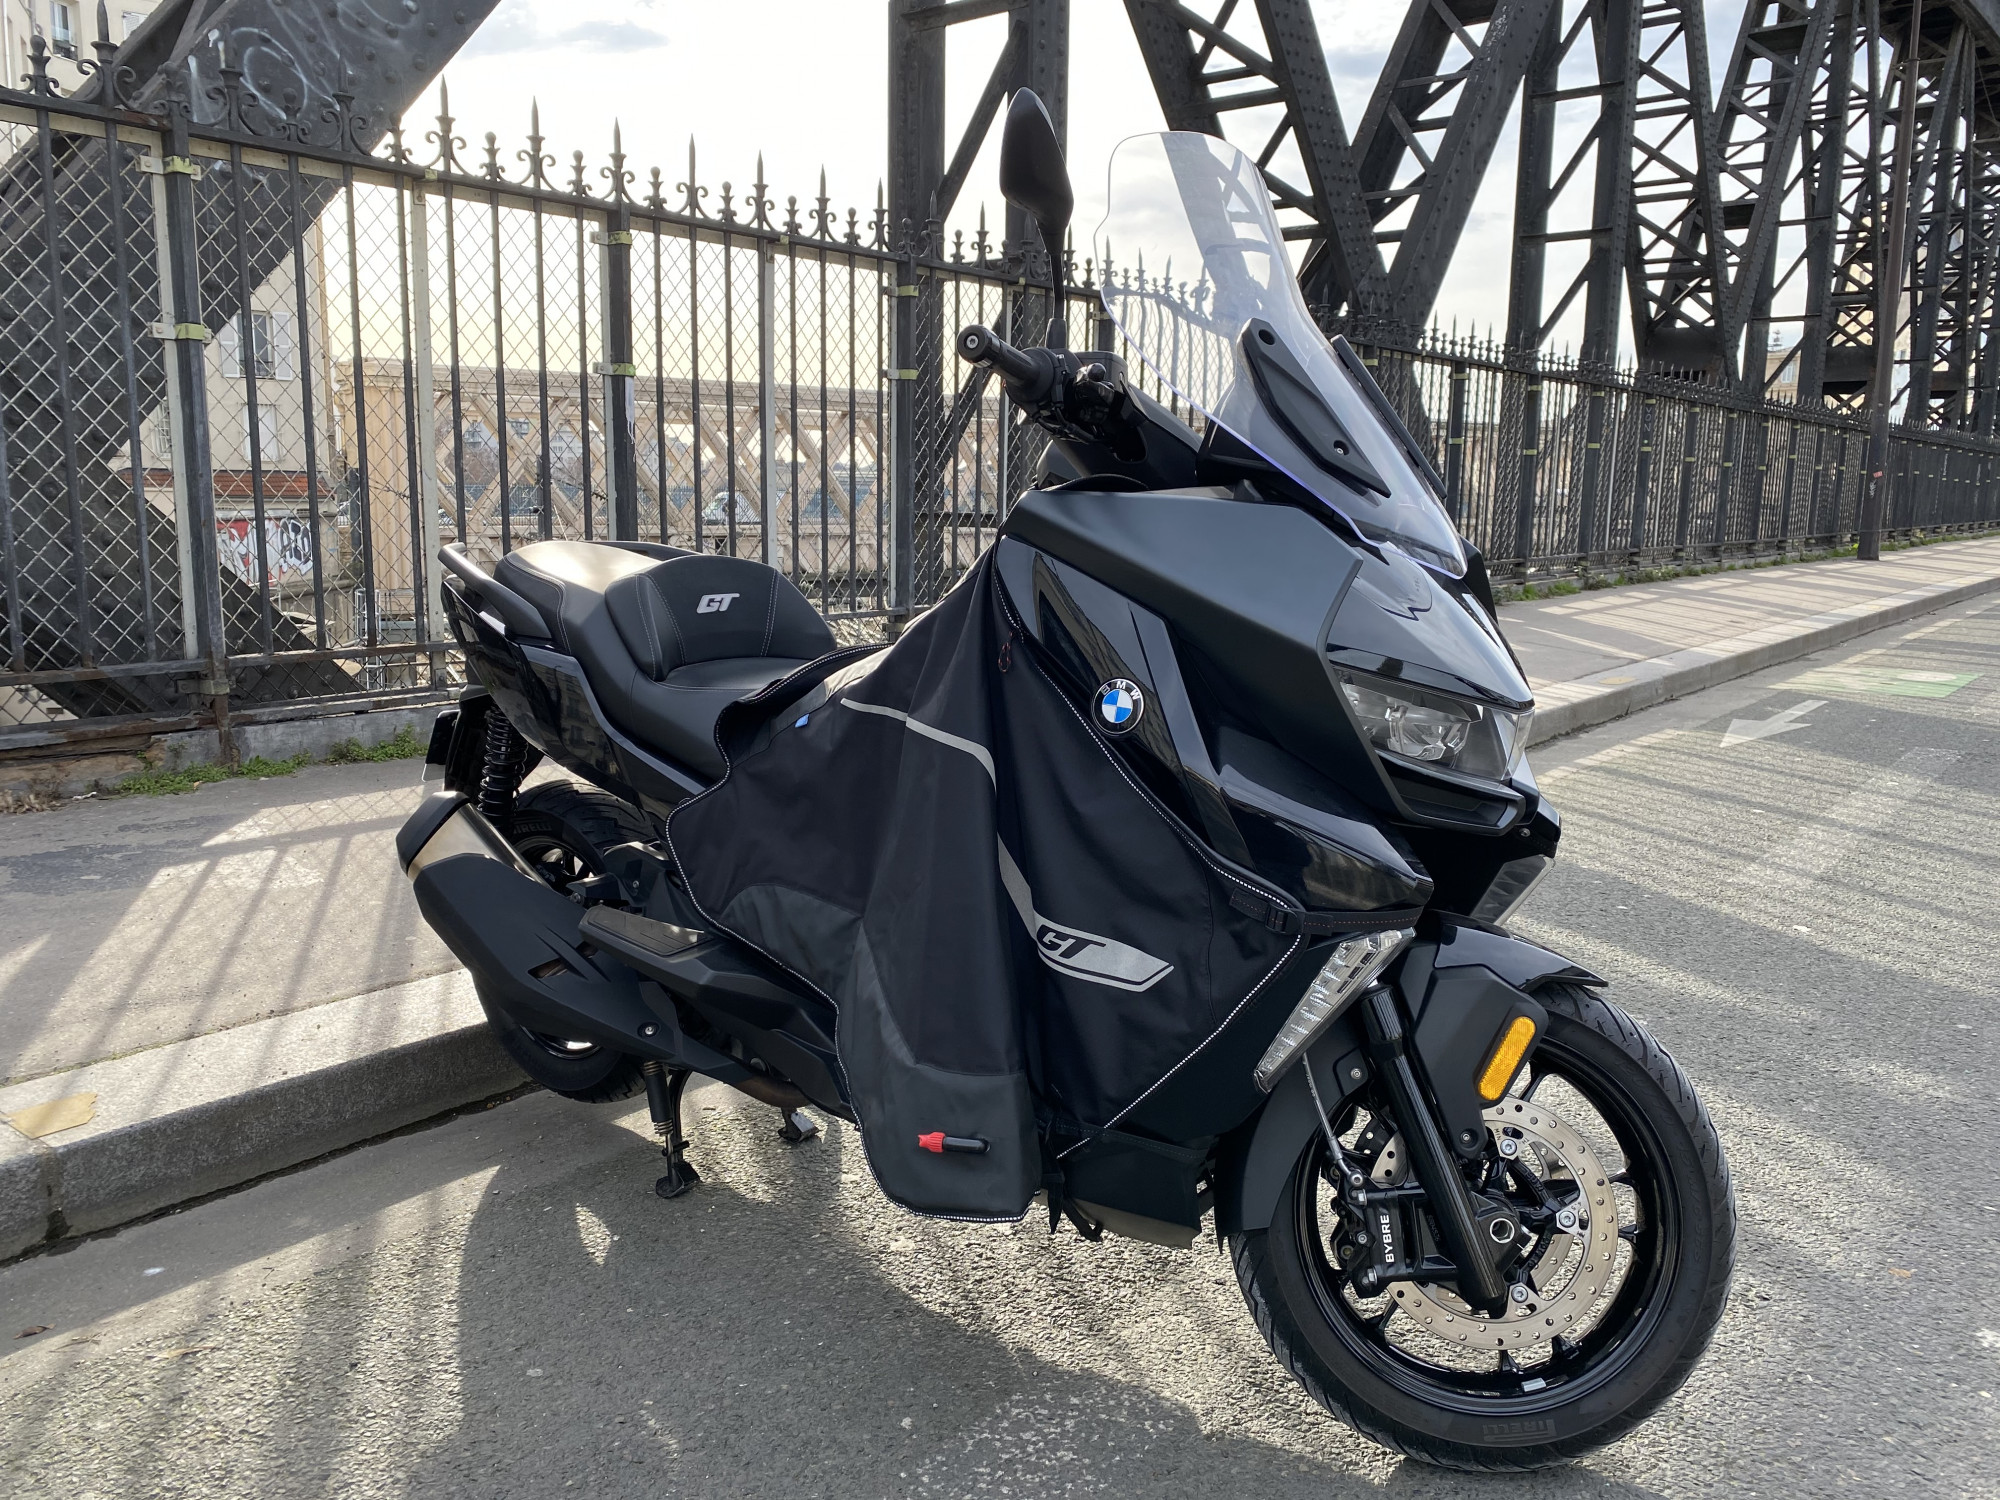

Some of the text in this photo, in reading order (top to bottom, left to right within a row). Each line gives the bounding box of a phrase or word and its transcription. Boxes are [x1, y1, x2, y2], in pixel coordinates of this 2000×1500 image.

[696, 592, 741, 614] GT
[1100, 680, 1141, 701] BMW
[1036, 924, 1107, 959] GT
[1379, 1214, 1395, 1263] BYBRE
[1481, 1418, 1557, 1442] PIRELLI
